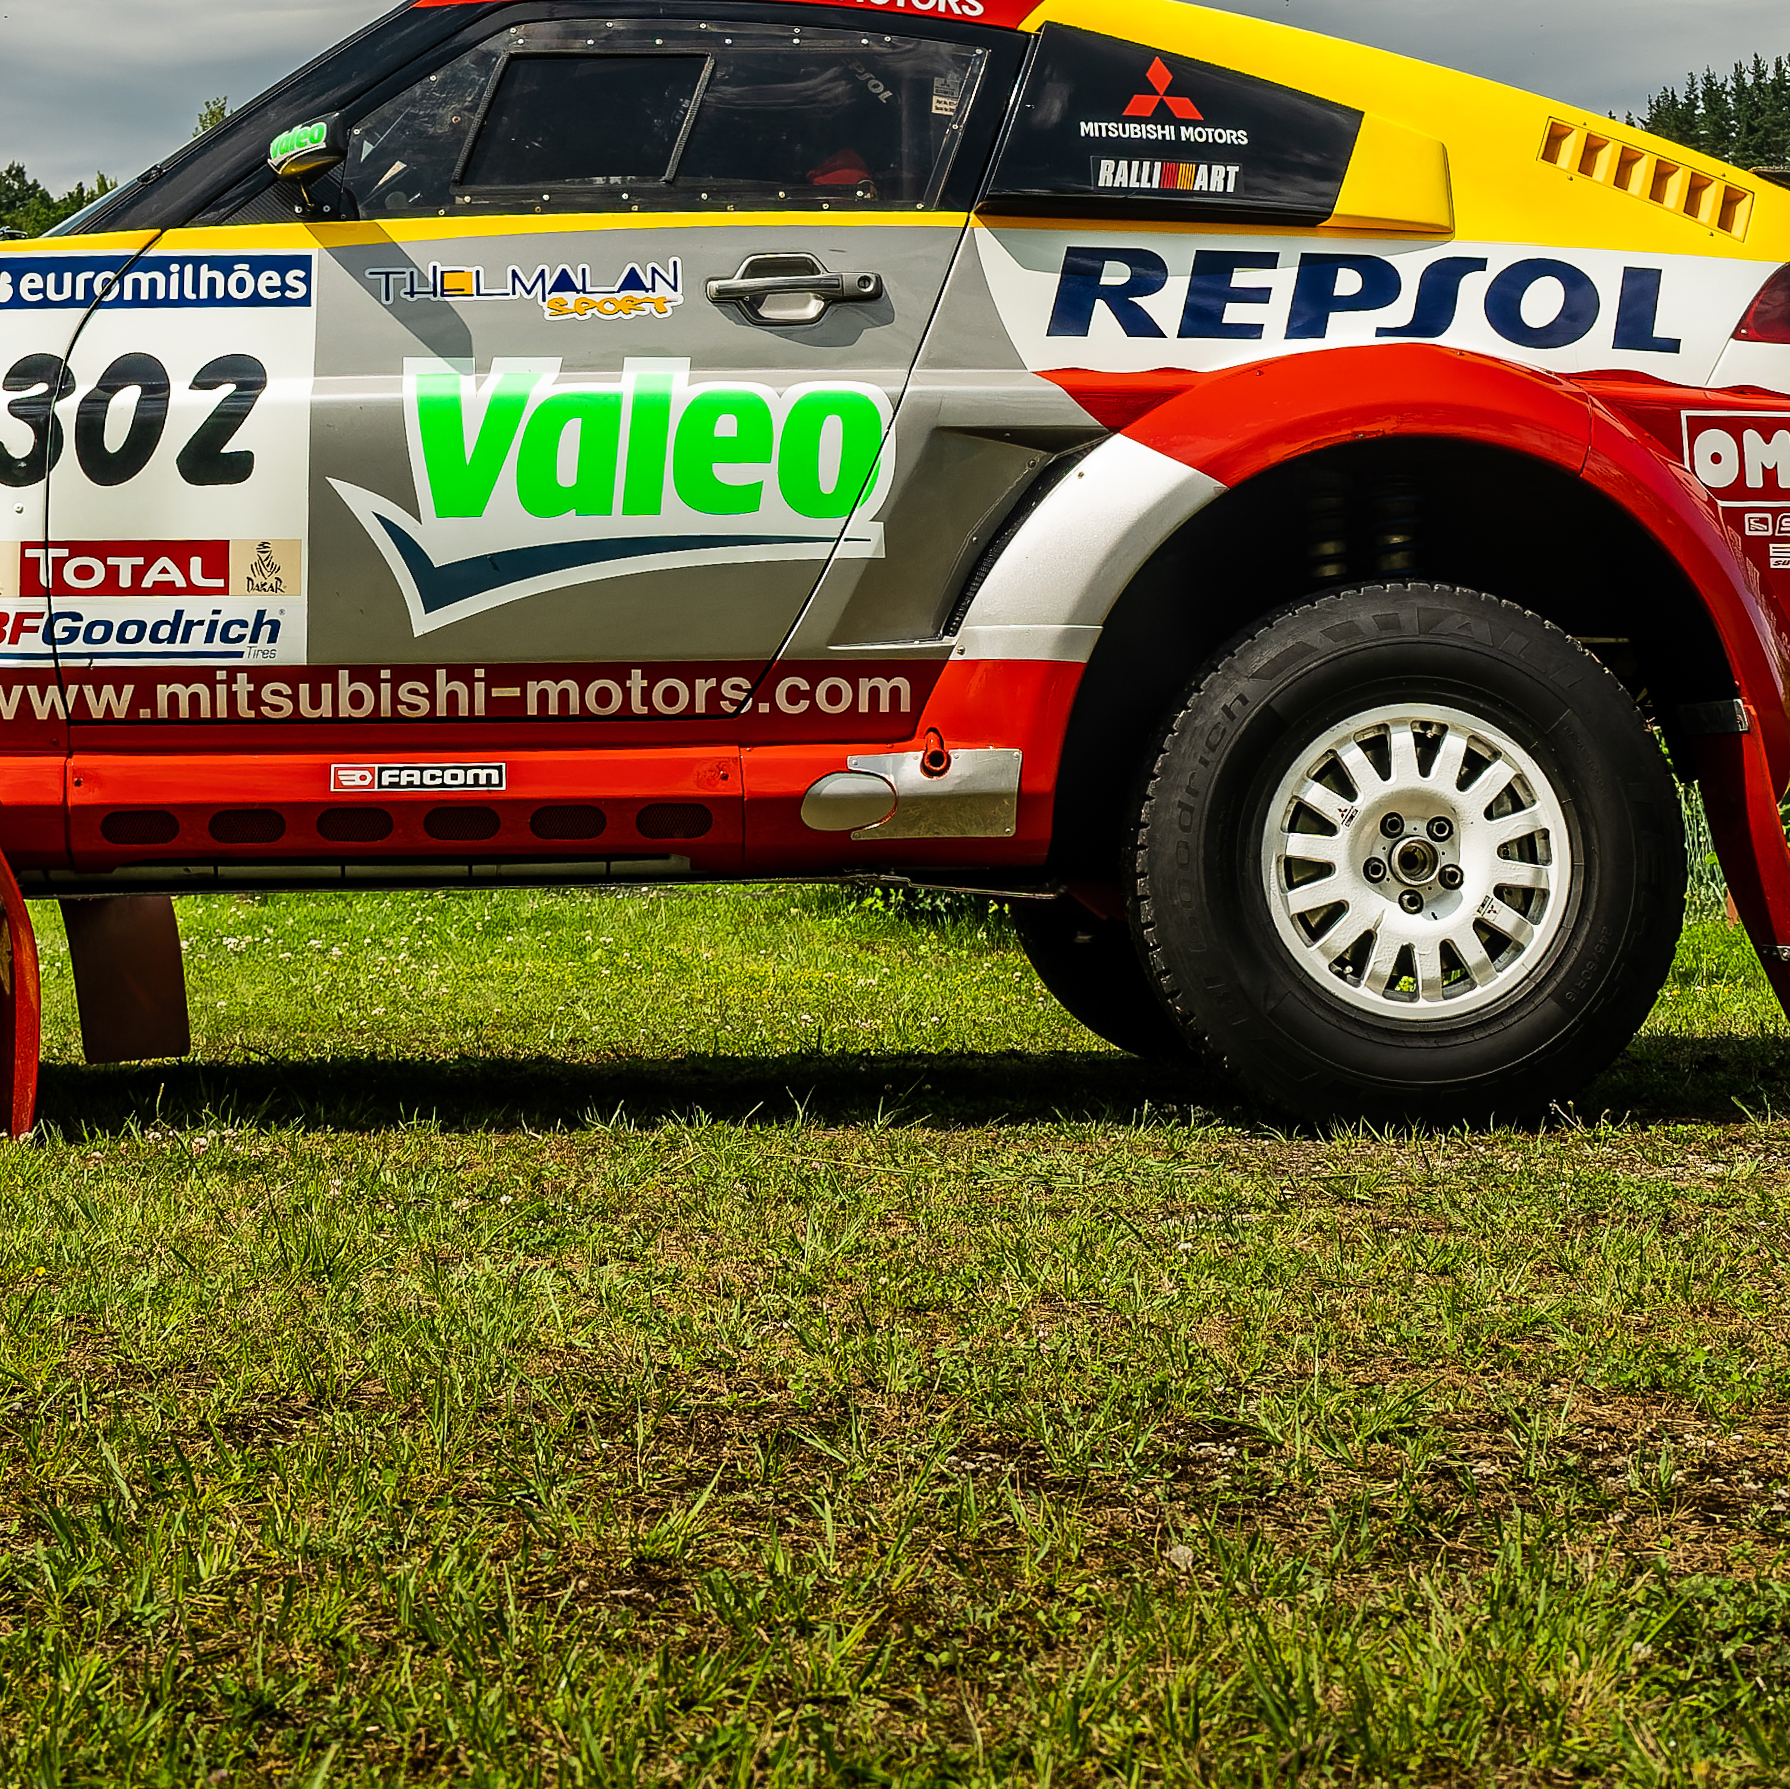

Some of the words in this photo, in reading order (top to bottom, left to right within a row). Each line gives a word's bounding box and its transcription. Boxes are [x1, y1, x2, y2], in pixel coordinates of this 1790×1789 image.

[1079, 121, 1175, 142] MITSUBISHI
[1180, 125, 1249, 145] MOTORS
[19, 263, 307, 304] euromilhões
[368, 260, 678, 303] THELMALAN
[547, 295, 675, 316] SPORT
[1046, 246, 1681, 354] REPSOL
[415, 373, 883, 518] Valeo
[25, 548, 225, 589] TOTAL
[246, 577, 286, 594] DAKAR
[246, 647, 277, 659] Tires
[381, 765, 500, 788] FACOM
